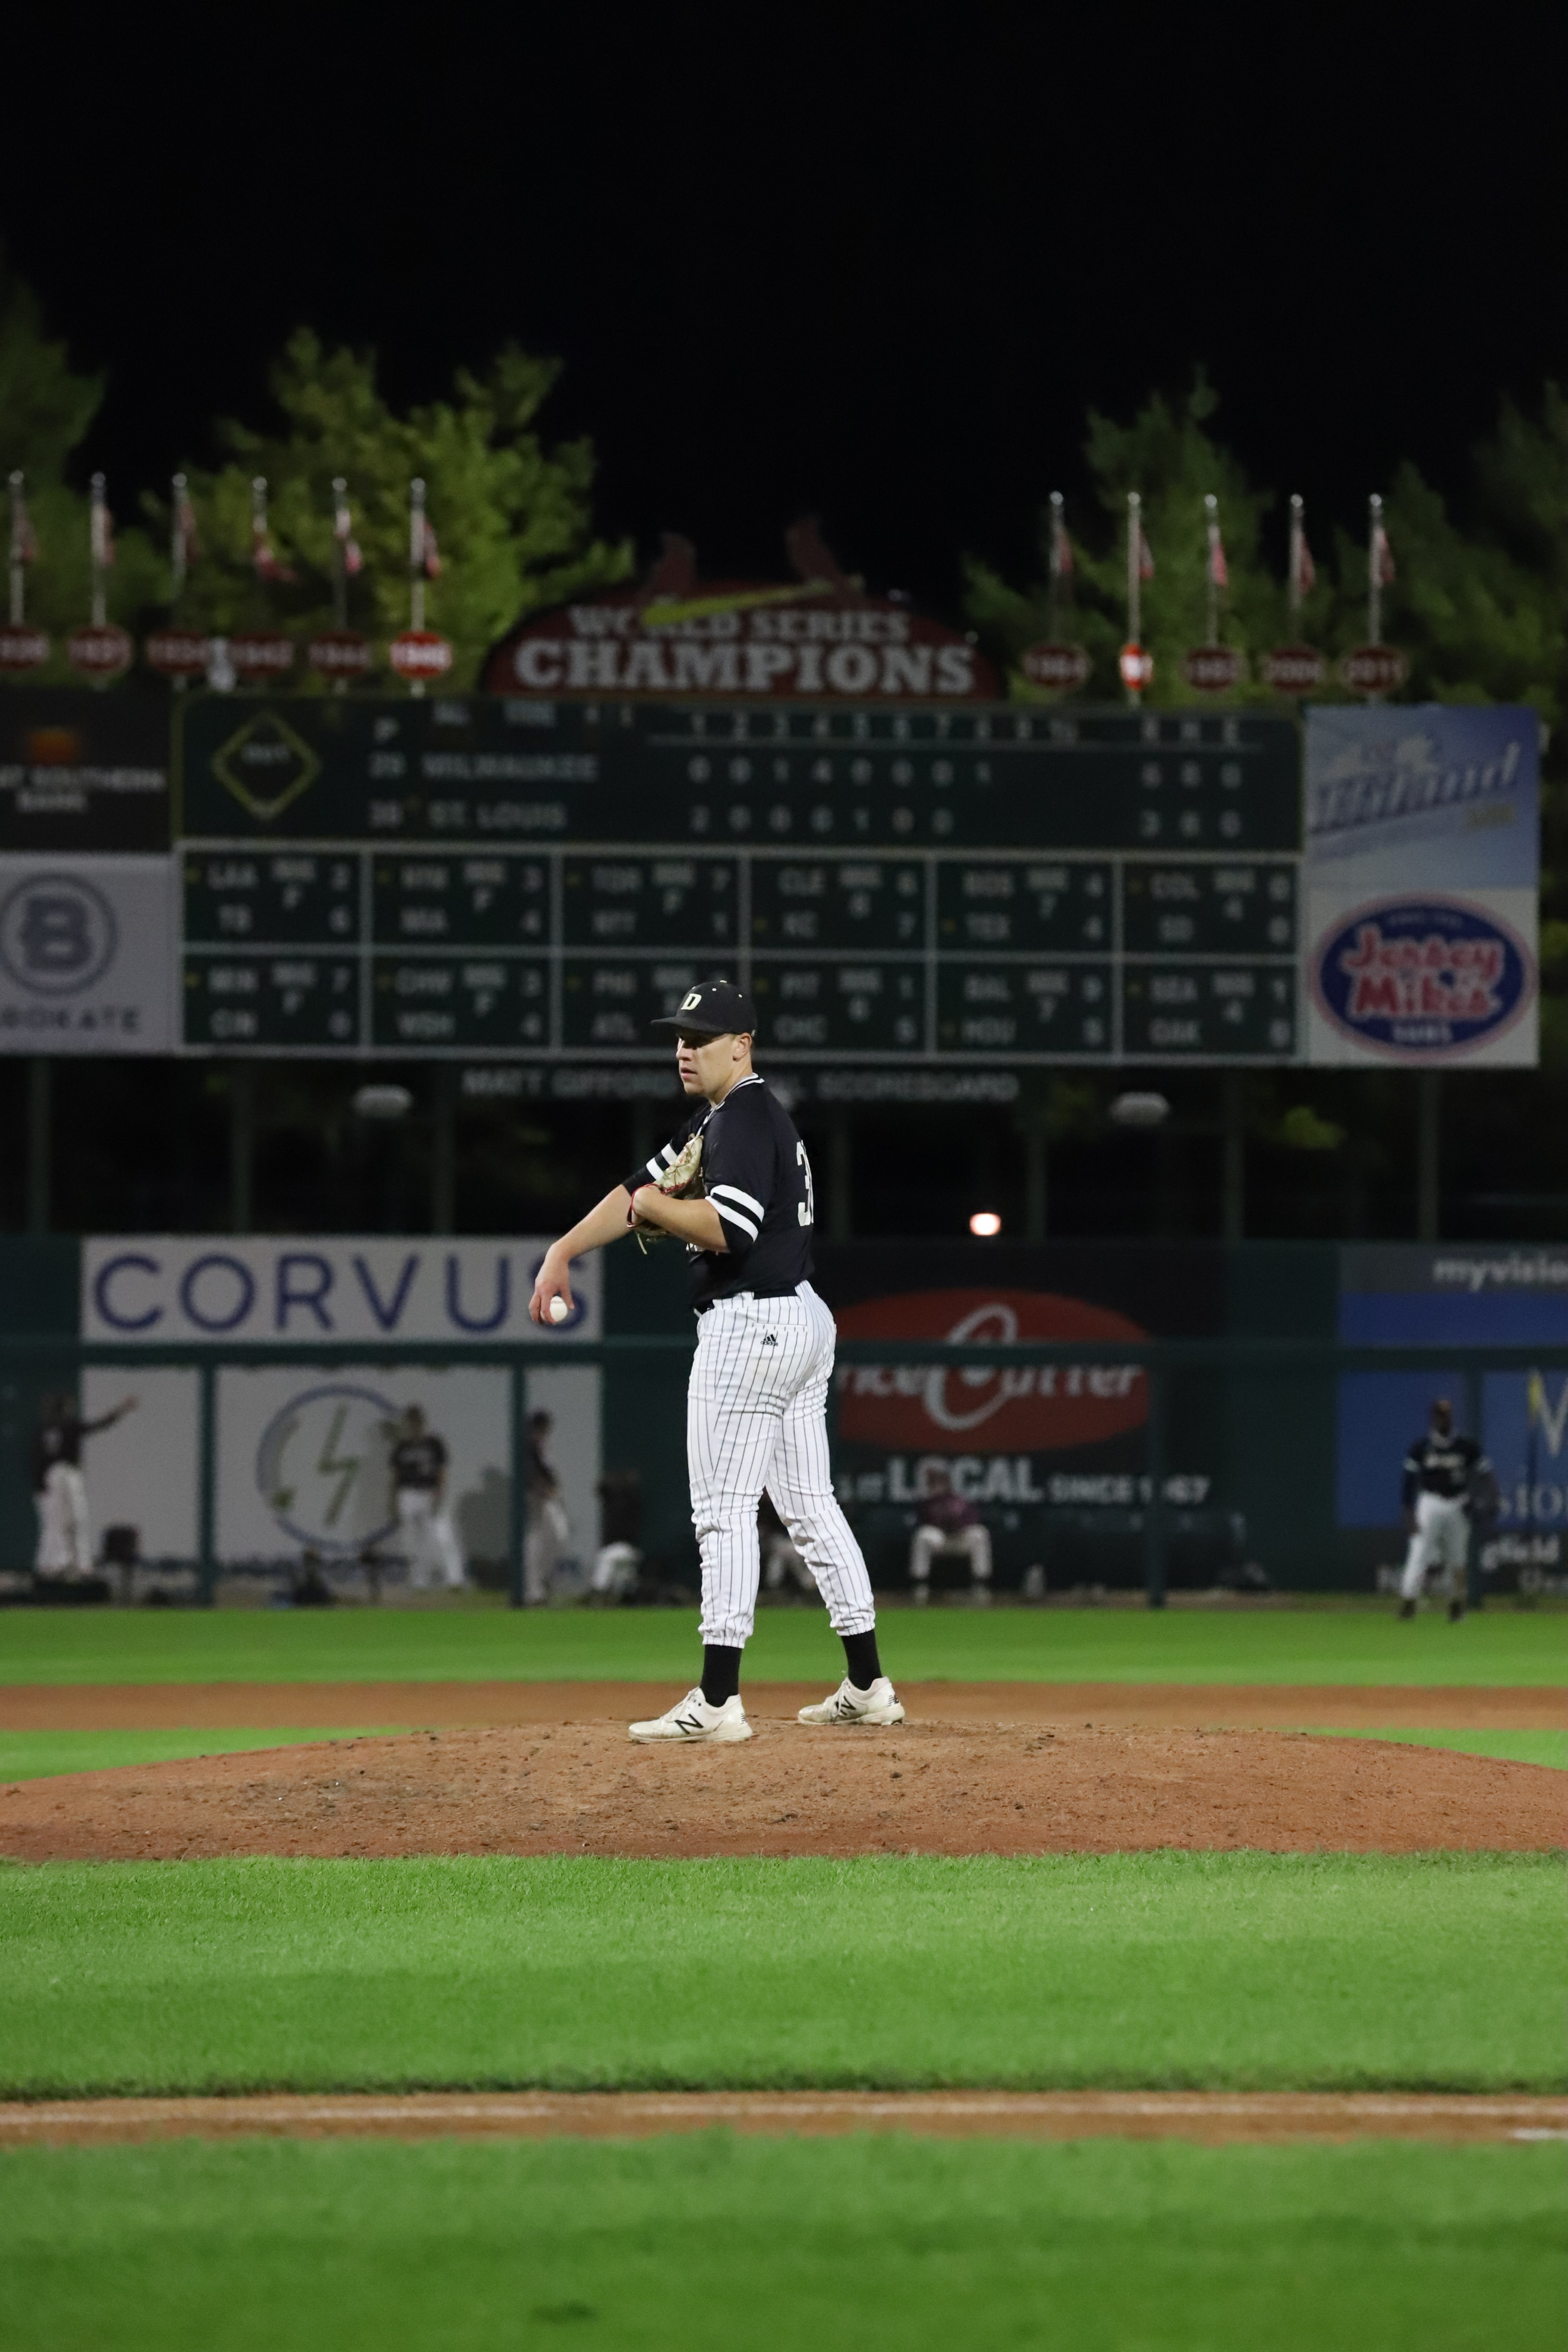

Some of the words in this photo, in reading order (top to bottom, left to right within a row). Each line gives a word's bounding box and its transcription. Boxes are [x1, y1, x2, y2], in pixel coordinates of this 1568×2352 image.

[749, 609, 911, 642] SERIES
[515, 640, 975, 693] CHAMPIONS
[421, 752, 598, 782] MILWAUKEE
[476, 801, 568, 829] LOUIS
[208, 863, 257, 889] LAA
[1344, 925, 1505, 983] Jersey
[680, 993, 702, 1010] D
[462, 1070, 543, 1095] MATT
[817, 1073, 1020, 1099] SCOREBOARD
[796, 1140, 814, 1226] 3
[94, 1255, 588, 1333] CORVUS
[1049, 1475, 1133, 1504] SINCE
